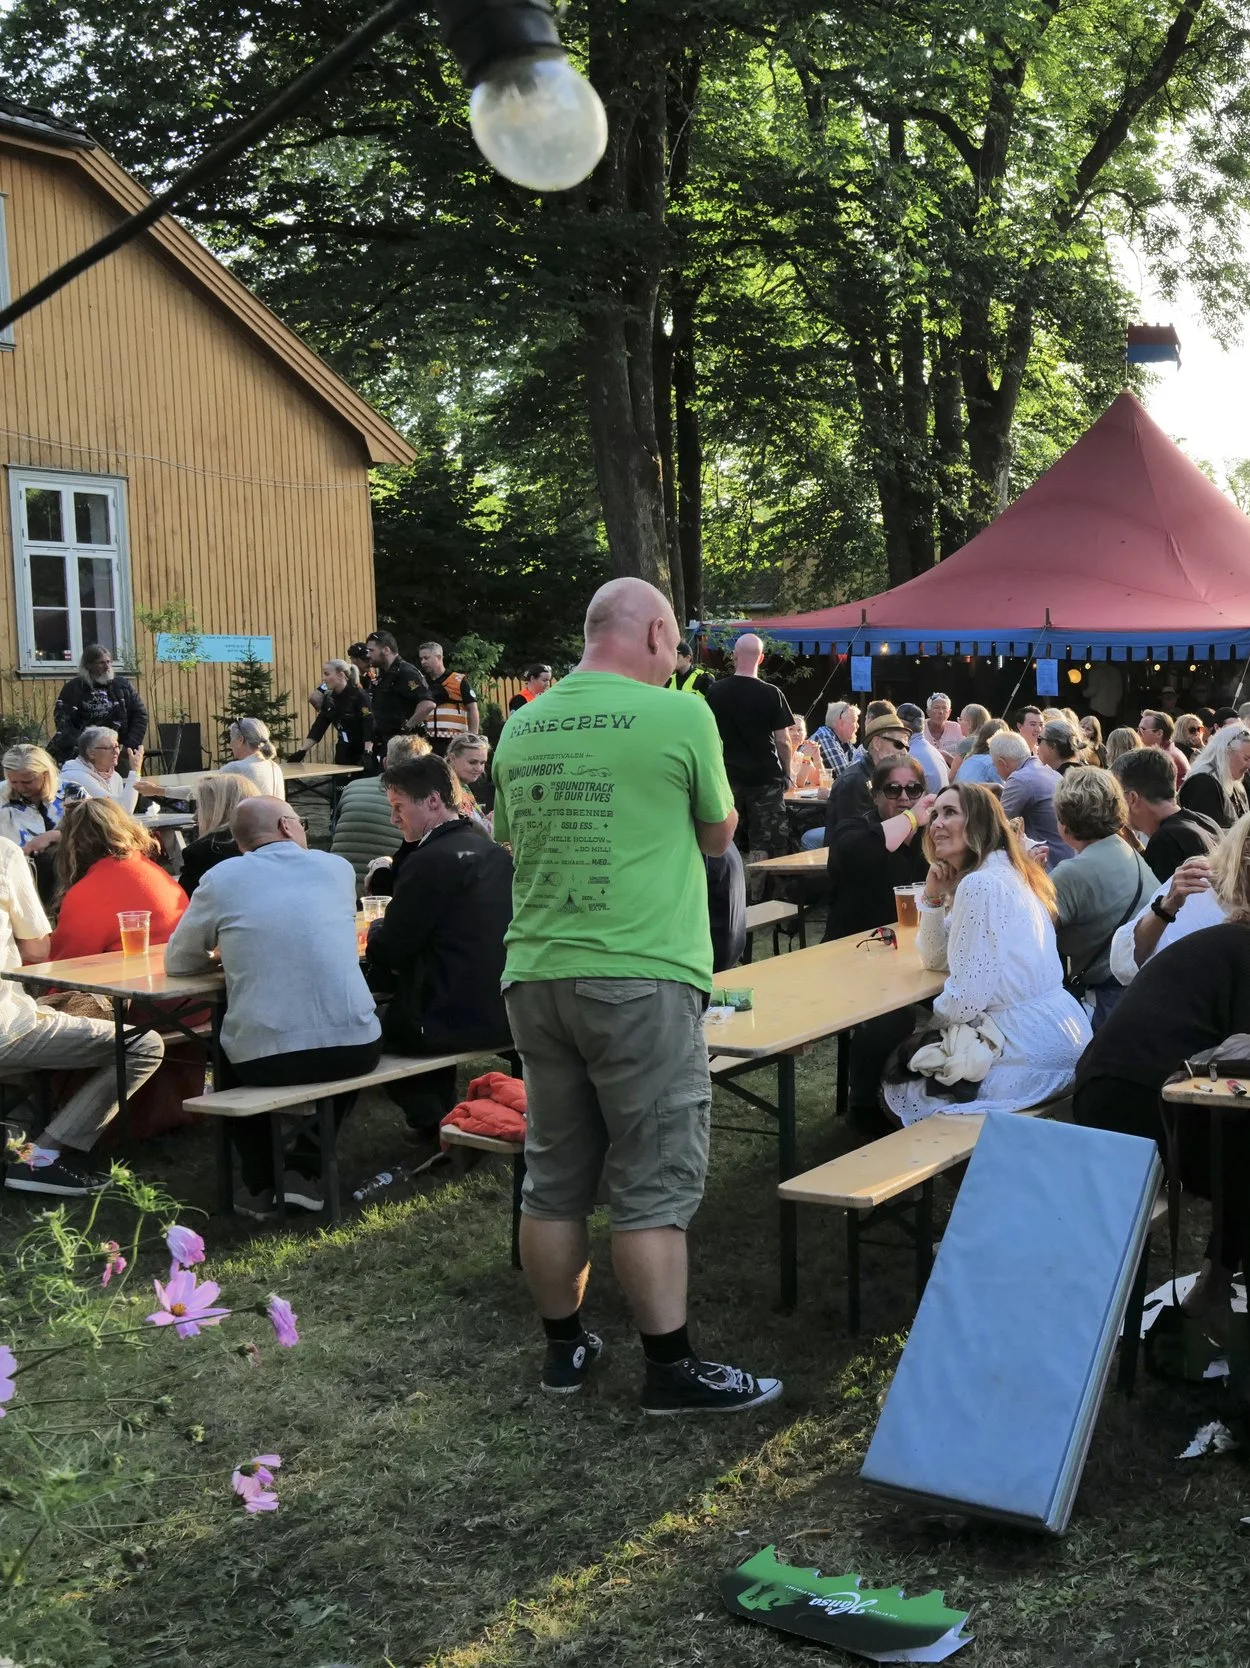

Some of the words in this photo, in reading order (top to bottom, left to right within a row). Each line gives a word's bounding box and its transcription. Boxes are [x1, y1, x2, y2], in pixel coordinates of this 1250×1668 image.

[556, 781, 615, 793] SOUNDTRACK
[554, 792, 563, 801] OF
[564, 791, 583, 802] OUR
[585, 792, 611, 803] LIVES
[566, 808, 614, 818] BRENNER
[561, 822, 577, 830] OSLO
[580, 822, 593, 830] ESS
[808, 1591, 878, 1616] Hansa
